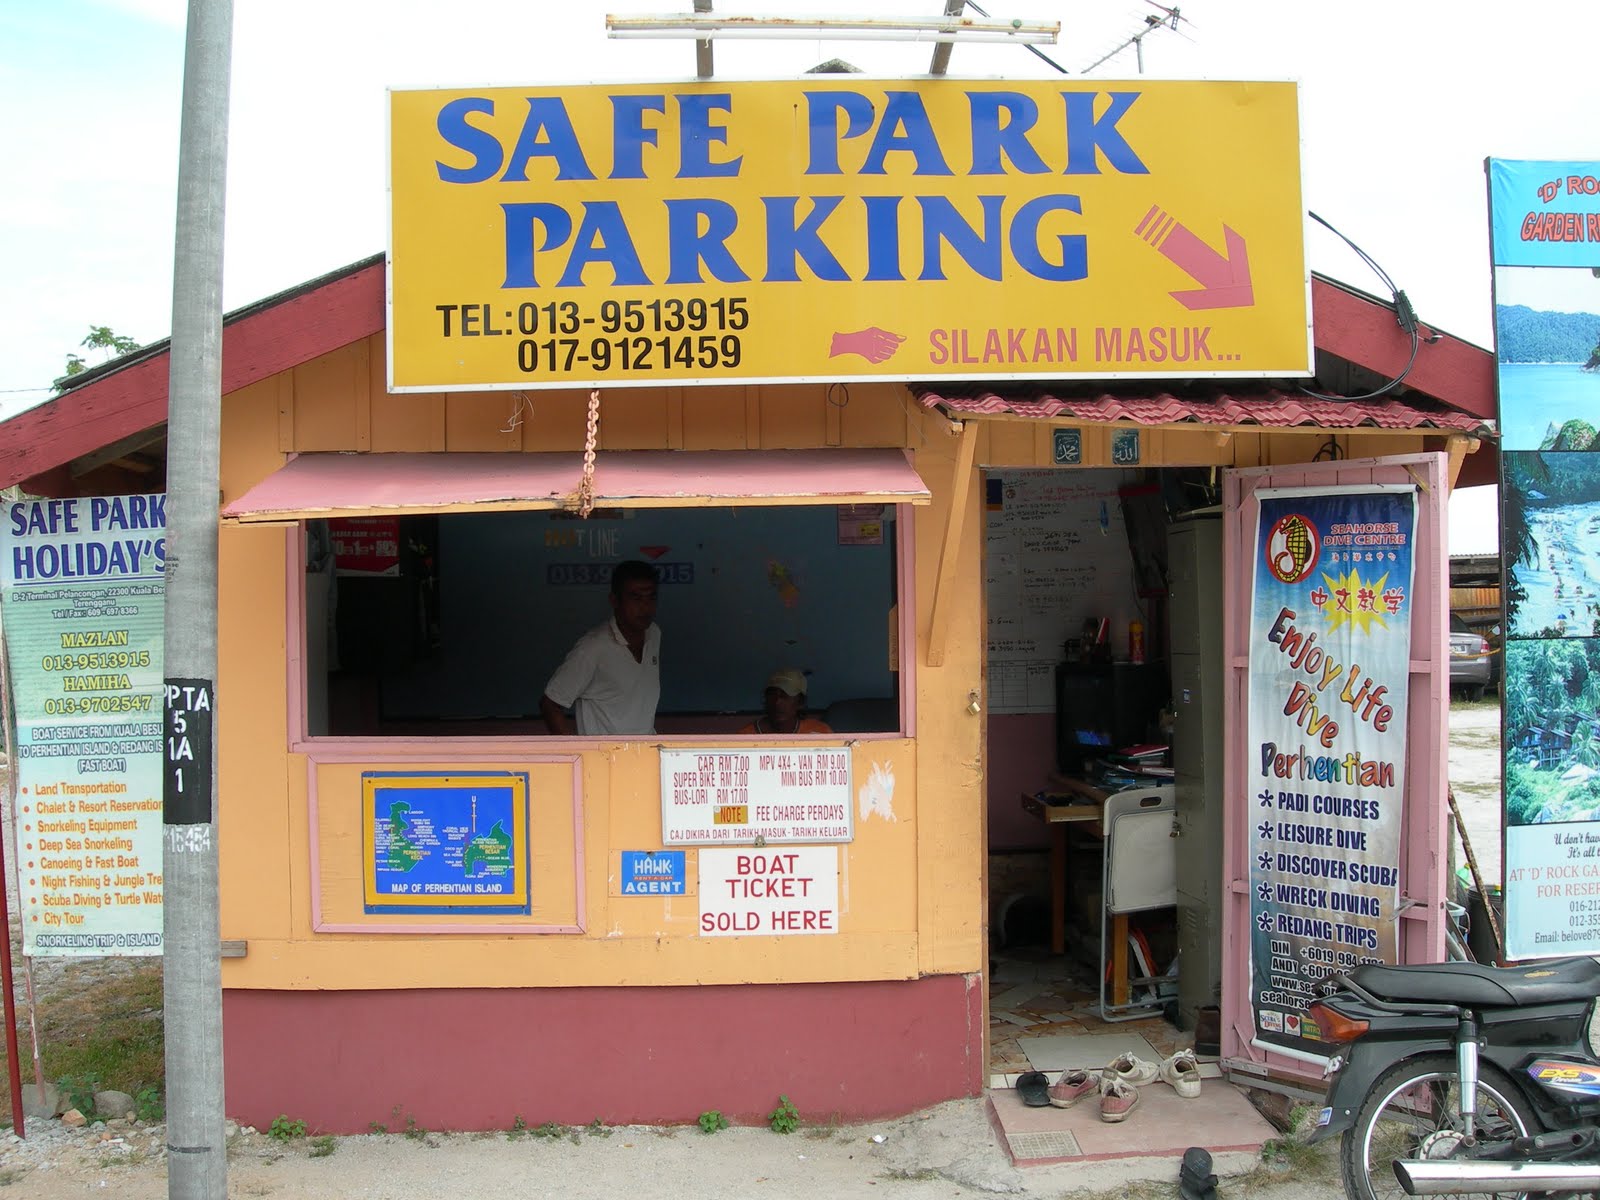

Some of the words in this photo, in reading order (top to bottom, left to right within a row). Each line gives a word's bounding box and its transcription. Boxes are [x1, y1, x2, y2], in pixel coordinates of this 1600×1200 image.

[435, 93, 743, 184] SAFE
[802, 91, 1150, 176] PARK
[1567, 175, 1600, 195] RO
[1520, 211, 1584, 242] GARDEN
[499, 194, 1088, 288] PARKING
[518, 335, 741, 372] 017-9121459
[929, 327, 1077, 365] SILAKAN
[11, 499, 78, 536] SAFE
[91, 495, 166, 531] PARK
[1331, 522, 1398, 534] SEAHORSE
[589, 527, 621, 557] LINE
[1324, 535, 1352, 546] DIVE
[1354, 534, 1406, 545] CENTRE
[13, 538, 165, 579] HOLIDAY'S
[131, 586, 152, 595] Kuala
[73, 599, 116, 608] Terengganu
[1310, 586, 1405, 615] 中文教学
[61, 630, 129, 648] MAZLAN
[1268, 606, 1343, 692] Enjoy
[42, 651, 150, 671] 013-9513915
[63, 674, 132, 692] HAMIHA
[45, 695, 152, 715] 013-9702547
[1340, 664, 1393, 732] Life
[173, 710, 187, 734] 5
[1283, 680, 1339, 748] Dive
[32, 728, 55, 741] BOAT
[56, 726, 88, 739] SERVICE
[89, 725, 112, 738] FROM
[113, 724, 141, 737] KUALA
[19, 746, 29, 758] TO
[31, 743, 81, 757] PERHENTIAN
[82, 742, 110, 756] ISLAND
[120, 739, 154, 754] REDANG
[698, 757, 714, 771] CAR
[718, 756, 732, 771] RM
[734, 755, 750, 771] 7.00
[759, 755, 774, 770] MPV
[798, 755, 813, 770] VAN
[816, 754, 828, 769] RM
[830, 754, 846, 770] 9.00
[1261, 741, 1395, 788] Perhentian
[674, 772, 698, 788] SUPER
[700, 772, 715, 787] BIKE
[720, 771, 732, 787] RM
[734, 771, 748, 787] 7.00
[781, 771, 796, 786] MINI
[799, 771, 813, 786] BUS
[815, 770, 827, 786] RM
[829, 770, 847, 786] 10.00
[35, 783, 58, 796] Land
[60, 782, 127, 796] Transportation
[674, 789, 708, 805] BUS-LORI
[717, 788, 728, 804] RM
[730, 788, 748, 804] 17.00
[36, 801, 66, 814] Chalet
[78, 799, 107, 813] Resort
[720, 806, 741, 822] NOTE
[756, 806, 770, 821] FEE
[773, 805, 805, 821] CHARGE
[807, 804, 844, 821] PERDAYS
[1278, 792, 1309, 813] PADI
[1313, 795, 1380, 820] COURSES
[37, 820, 86, 834] Snorkeling
[88, 819, 138, 834] Equipment
[670, 829, 684, 840] CAJ
[686, 828, 710, 839] DIKIRA
[713, 828, 730, 839] DARI
[733, 827, 759, 838] TARIKH
[761, 827, 786, 838] MASUK
[792, 827, 817, 837] TARIKH
[819, 826, 847, 837] KELUAR
[39, 839, 63, 852] Deep
[65, 838, 82, 850] Sea
[84, 837, 133, 851] Snorkeling
[1277, 823, 1333, 847] LEISURE
[1337, 829, 1367, 851] DIVE
[1564, 832, 1583, 845] don't
[1585, 832, 1600, 843] hav
[1583, 846, 1595, 857] all
[40, 856, 82, 871] Canoeing
[95, 856, 115, 868] Fast
[117, 855, 139, 868] Boat
[634, 856, 673, 874] HAWK
[737, 854, 799, 875] BOAT
[1277, 854, 1347, 880] DISCOVER
[41, 874, 67, 889] Night
[69, 873, 100, 889] Fishing
[114, 872, 145, 888] Jungle
[1509, 868, 1525, 882] AT
[1547, 866, 1580, 879] ROCK
[1583, 865, 1600, 877] GA
[392, 884, 410, 893] MAP
[411, 884, 422, 893] OF
[424, 884, 472, 893] PERHENTIAN
[474, 883, 502, 893] ISLAND
[625, 881, 682, 893] AGENT
[725, 878, 813, 898] TICKET
[1537, 884, 1561, 898] FOR
[43, 894, 71, 906] Scuba
[73, 893, 101, 908] Diving
[114, 892, 141, 905] Turtle
[1276, 884, 1328, 909] WRECK
[1331, 893, 1381, 917] DIVING
[43, 912, 62, 926] City
[64, 911, 85, 924] Tour
[701, 912, 760, 931] SOLD
[771, 910, 832, 930] HERE
[36, 934, 94, 948] SNORKELING
[94, 933, 115, 947] TRIP
[126, 932, 161, 947] ISLAND
[1277, 914, 1332, 940] REDANG
[1335, 923, 1377, 949] TRIPS
[1535, 930, 1560, 943] Email:
[1271, 940, 1290, 955] DIN
[1300, 946, 1334, 962] +6019
[1271, 957, 1298, 974] ANDY
